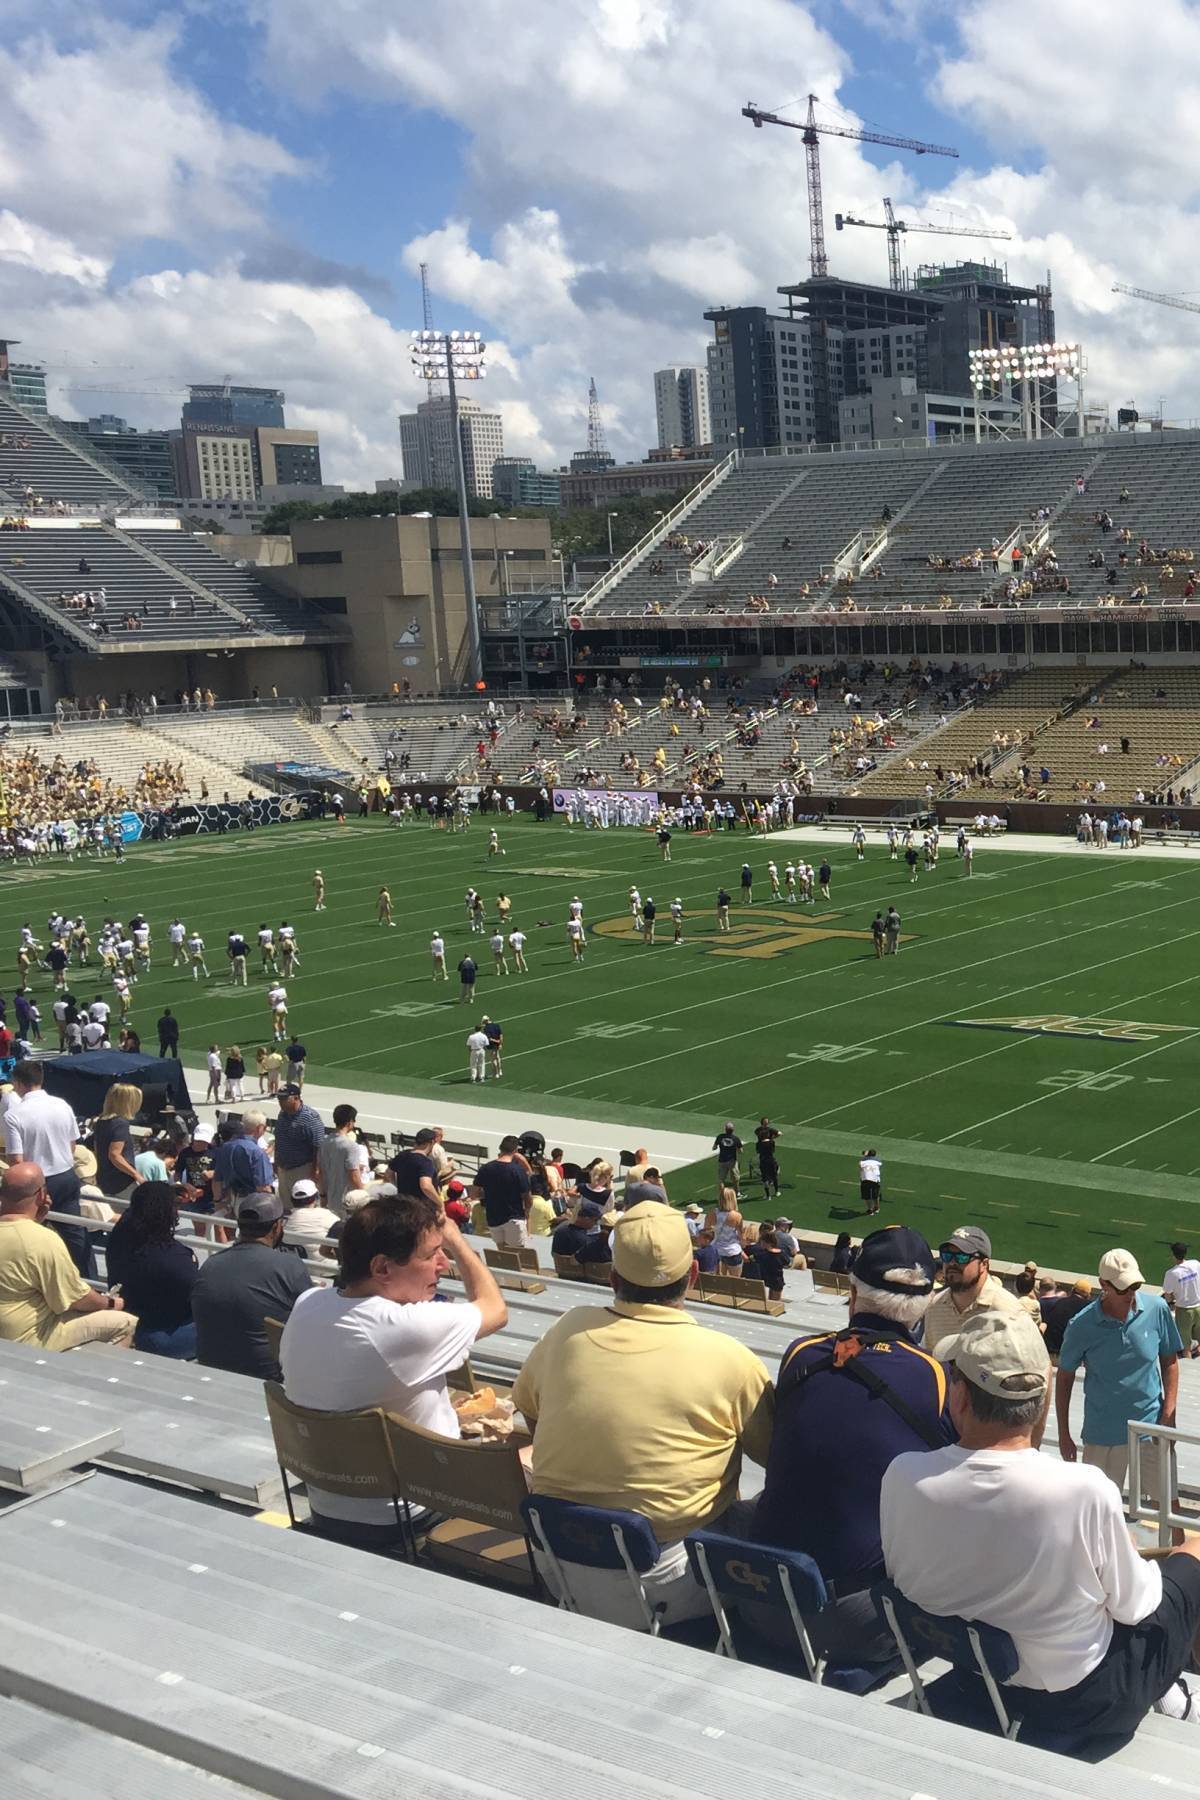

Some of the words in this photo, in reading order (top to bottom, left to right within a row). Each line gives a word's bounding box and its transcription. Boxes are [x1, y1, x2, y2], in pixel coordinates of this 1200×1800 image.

[186, 423, 240, 433] RENAISSANCE
[930, 1014, 1200, 1043] ACC
[786, 1043, 879, 1063] 30
[1036, 1069, 1136, 1092] 20
[407, 1480, 514, 1522] www.stingerseats.com
